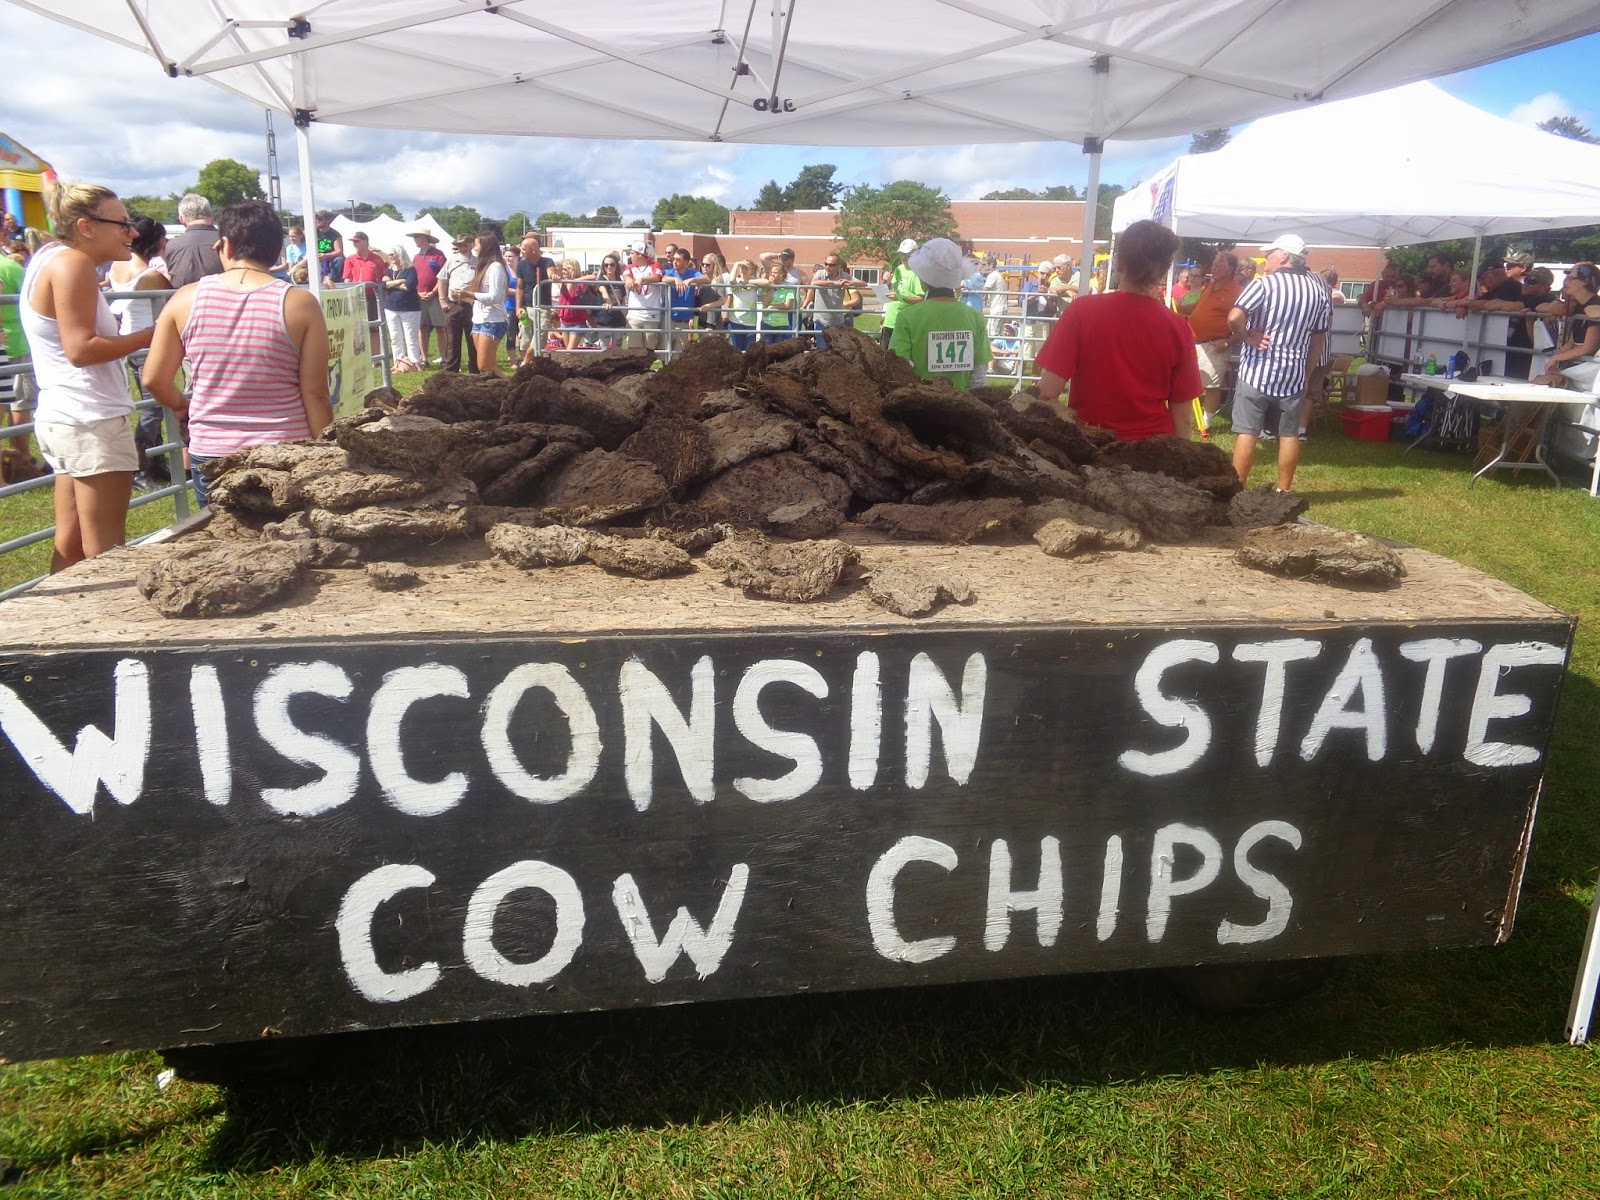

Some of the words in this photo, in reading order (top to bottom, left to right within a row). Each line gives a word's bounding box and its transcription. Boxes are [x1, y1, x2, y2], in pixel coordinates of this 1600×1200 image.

[936, 341, 967, 363] 147
[956, 332, 970, 340] STATE
[0, 650, 990, 818] WISCONSIN
[1119, 637, 1568, 778] STATE
[334, 859, 750, 1004] COW
[865, 819, 1304, 964] CHIPS
